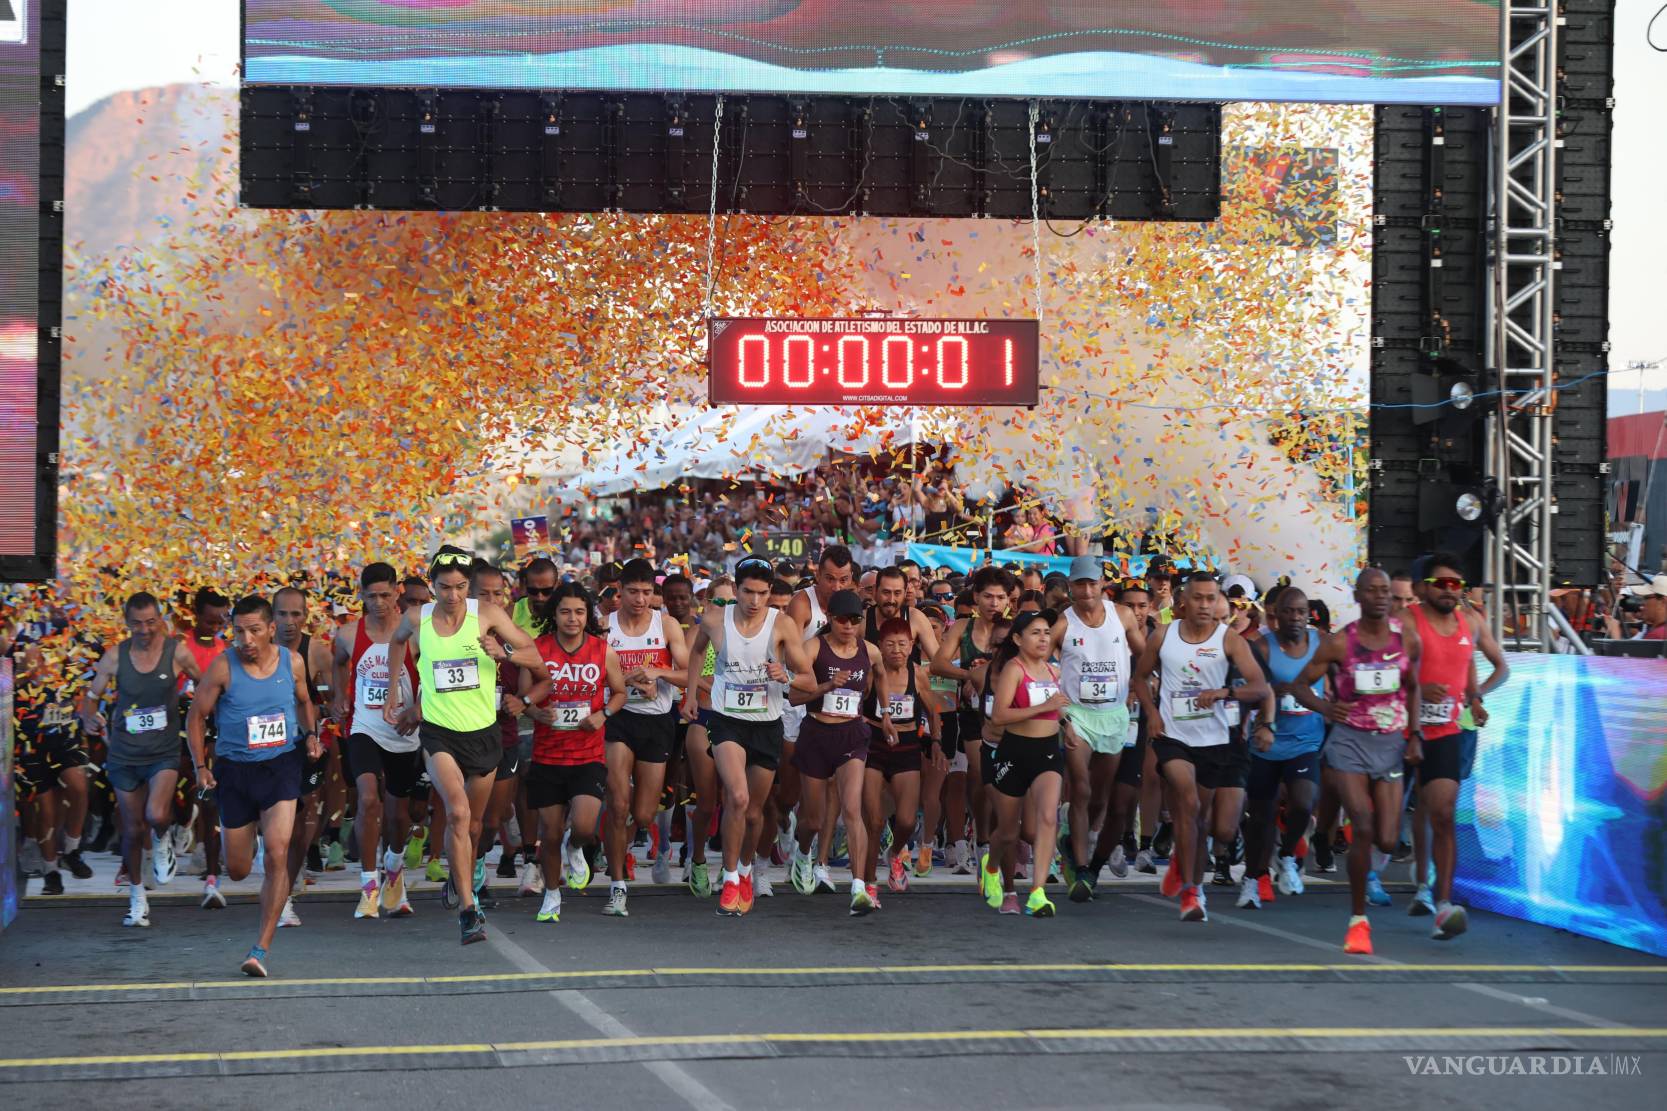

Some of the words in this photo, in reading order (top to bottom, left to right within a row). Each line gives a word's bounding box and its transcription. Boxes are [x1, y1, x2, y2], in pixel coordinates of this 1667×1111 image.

[765, 321, 819, 332] ASOCIACION
[822, 321, 834, 332] DE
[834, 321, 884, 332] ATLETISMO
[886, 321, 902, 332] DEL
[904, 321, 941, 333] ESTADO
[944, 321, 957, 333] DE
[447, 668, 464, 683] 33
[1374, 672, 1382, 686] 6
[1092, 683, 1106, 697] 34
[738, 692, 753, 706] 87
[835, 696, 850, 711] 51
[139, 715, 154, 727] 39
[563, 709, 578, 723] 22
[259, 722, 284, 739] 744
